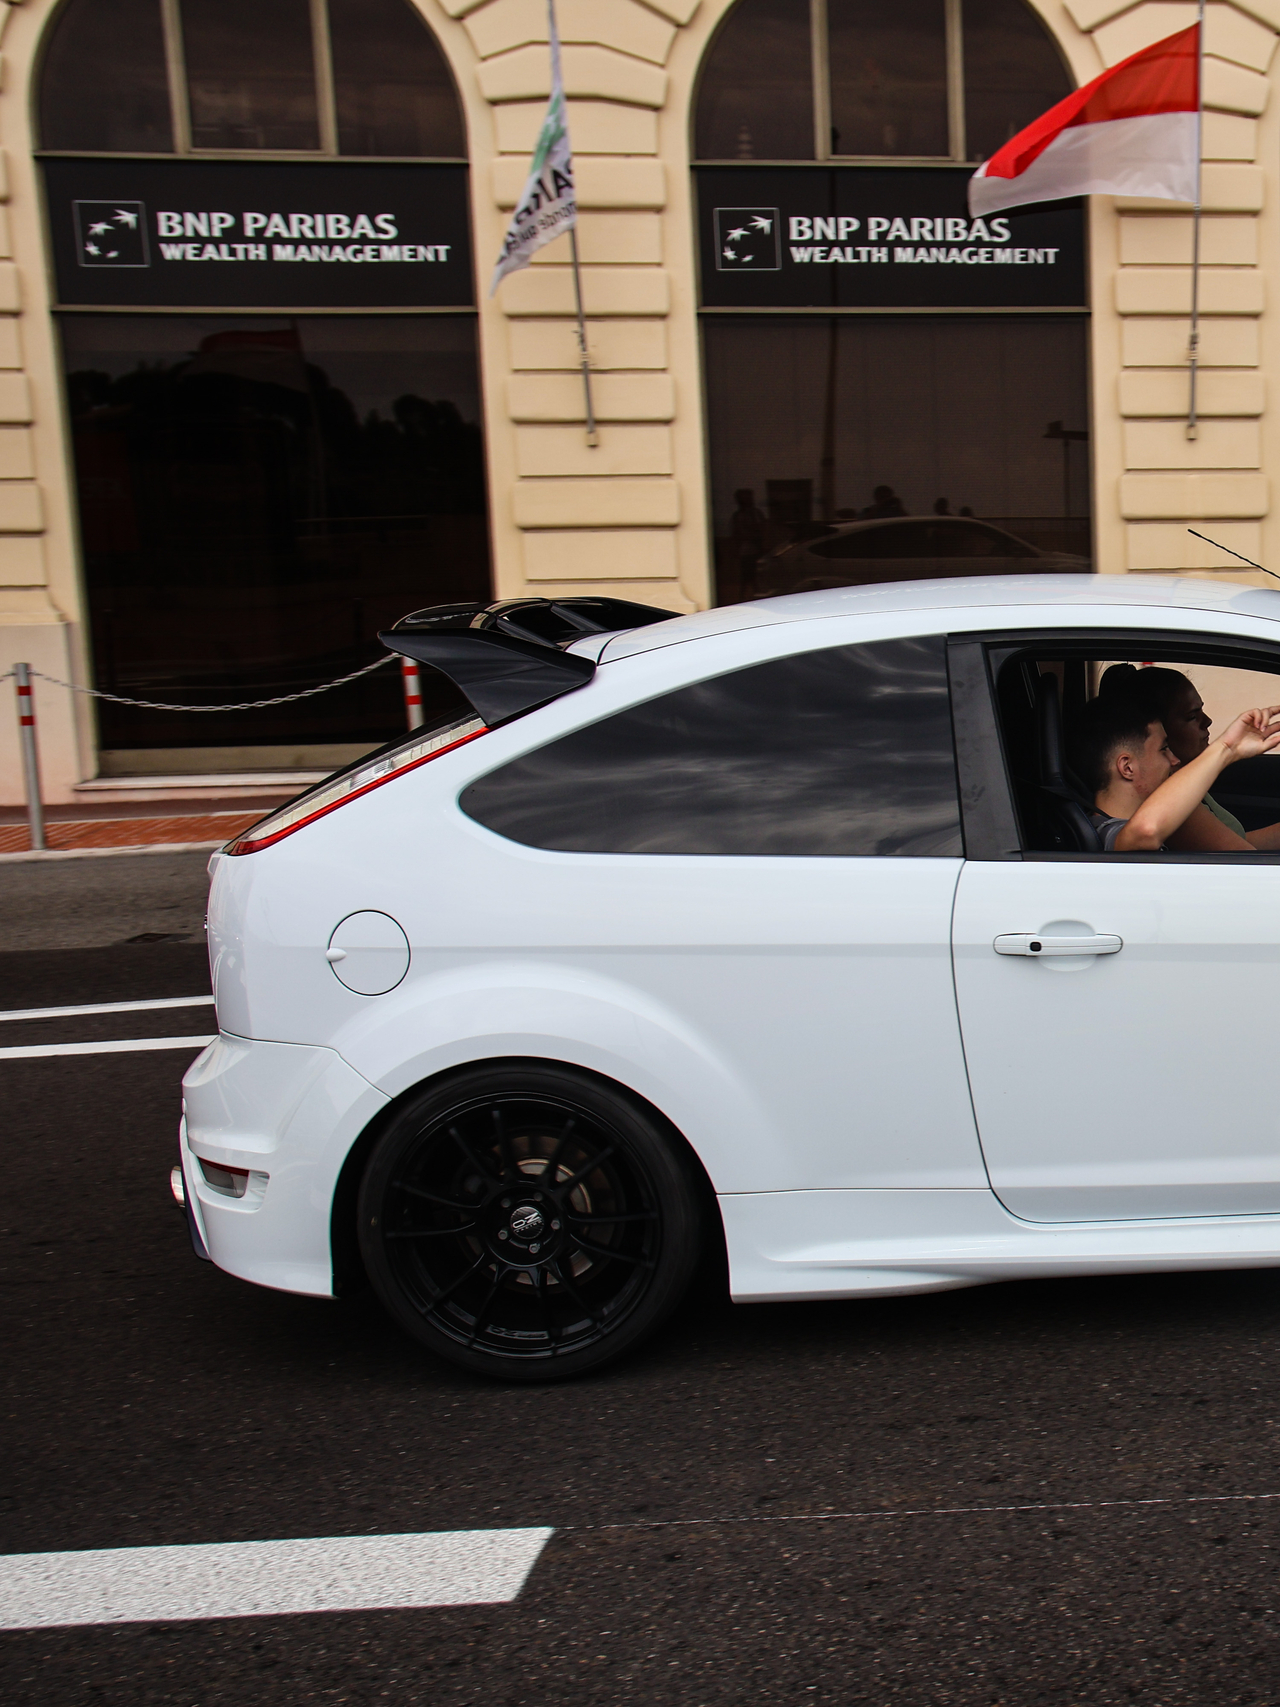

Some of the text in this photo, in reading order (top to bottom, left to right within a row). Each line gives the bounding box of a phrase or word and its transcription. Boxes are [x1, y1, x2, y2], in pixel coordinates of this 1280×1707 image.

[157, 211, 398, 240] BNP PARIBAS
[788, 216, 1011, 243] BNP PARIBAS
[159, 243, 451, 263] WEALTH MANAGEMENT
[789, 246, 1060, 265] WEALTH MANAGEMENT
